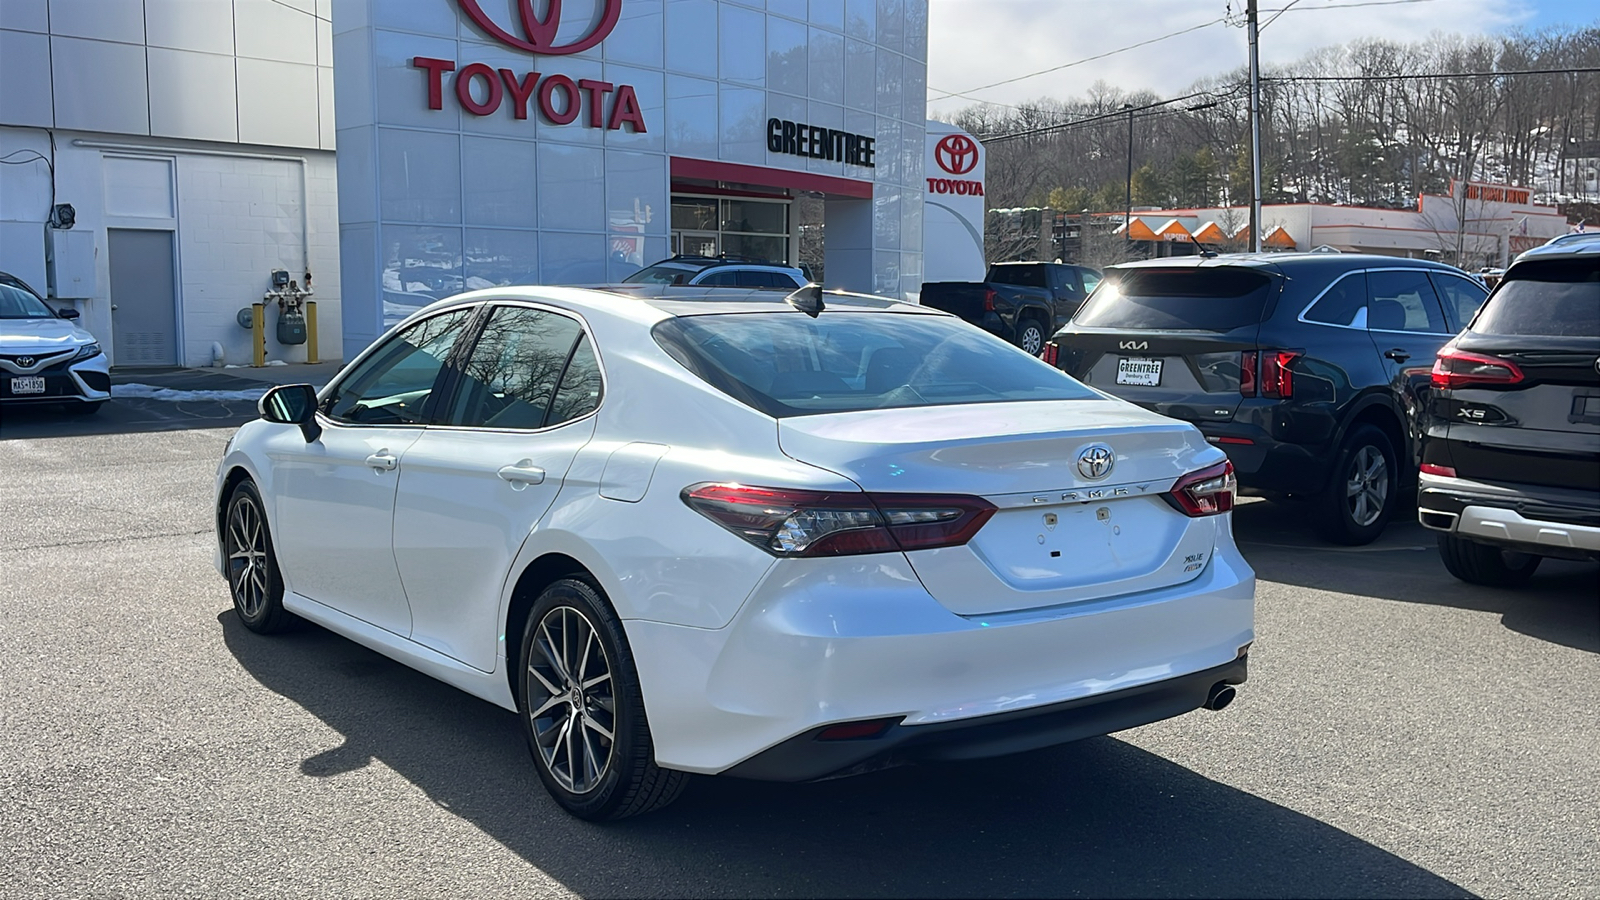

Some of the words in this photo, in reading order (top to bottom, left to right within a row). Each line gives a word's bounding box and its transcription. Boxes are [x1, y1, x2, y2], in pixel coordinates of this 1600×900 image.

[413, 56, 647, 133] TOYOTA
[767, 117, 875, 168] GREENTREE
[926, 178, 985, 196] TOYOTA
[1163, 232, 1188, 242] NURSERY
[1120, 362, 1160, 374] GREENTREE
[1457, 408, 1486, 419] X5
[1033, 484, 1150, 503] CAMRY
